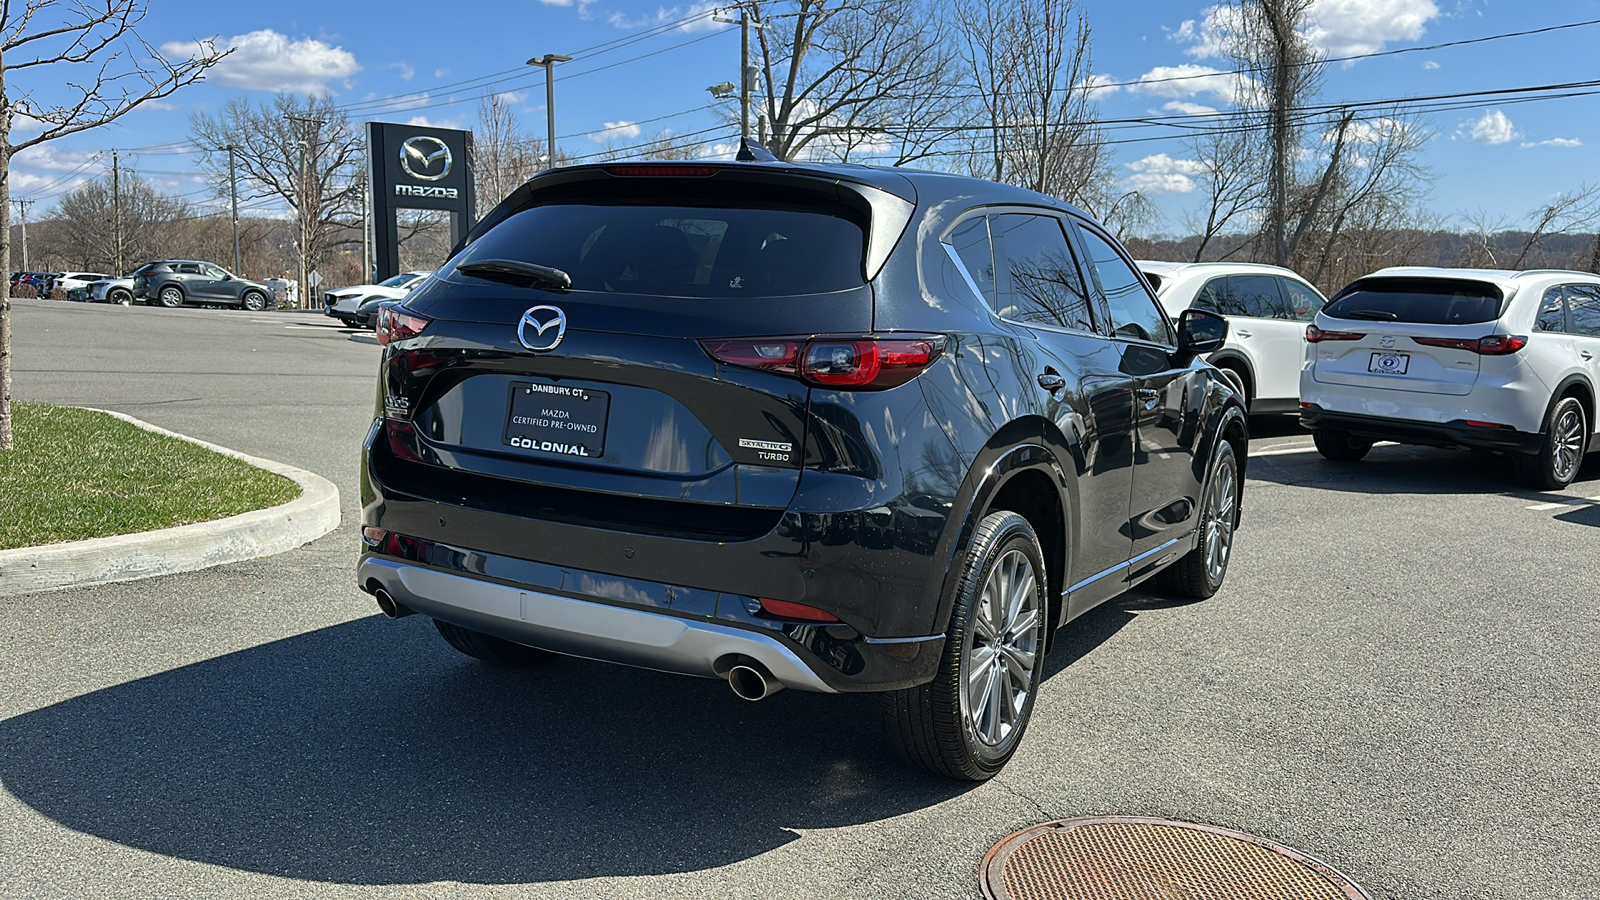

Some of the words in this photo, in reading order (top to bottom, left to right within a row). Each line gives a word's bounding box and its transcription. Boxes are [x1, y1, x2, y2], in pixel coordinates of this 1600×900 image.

[572, 388, 584, 397] CT
[540, 408, 570, 419] MAZDA
[512, 416, 549, 427] CERTIFIED
[550, 420, 597, 433] PRE-OWNED
[510, 437, 589, 456] COLONIAL
[757, 451, 790, 462] TURBO
